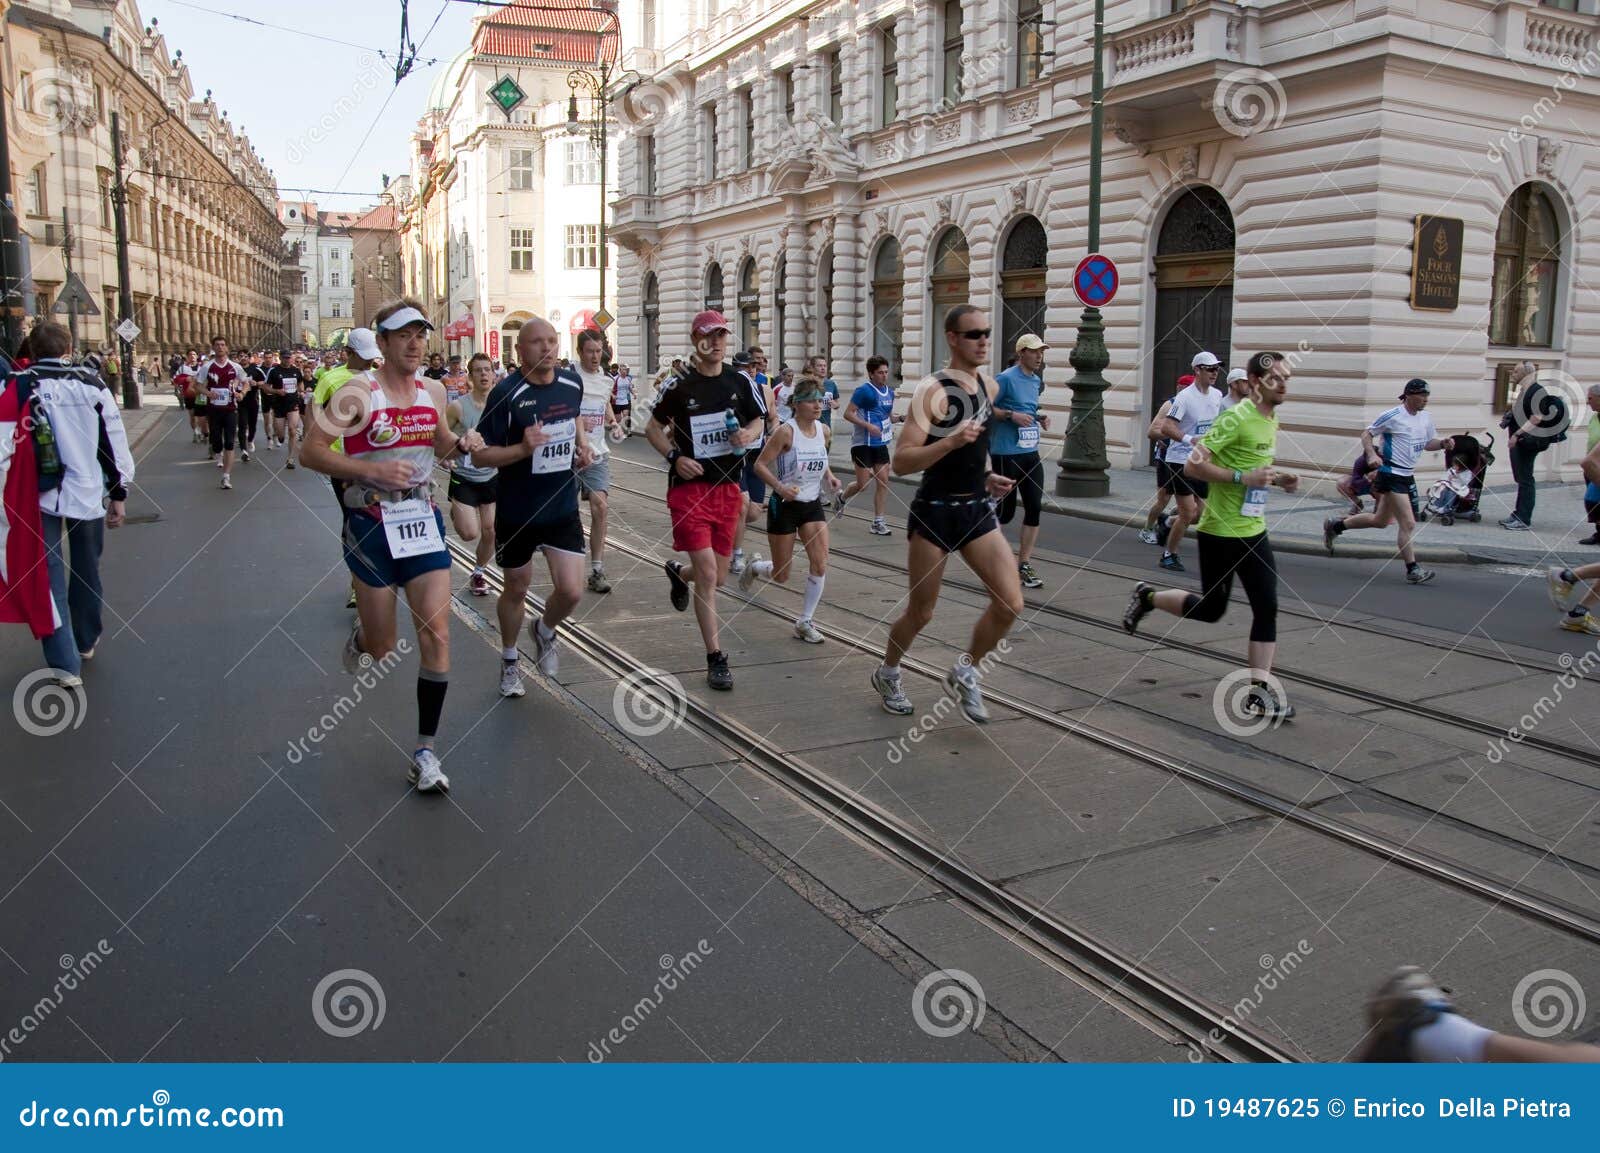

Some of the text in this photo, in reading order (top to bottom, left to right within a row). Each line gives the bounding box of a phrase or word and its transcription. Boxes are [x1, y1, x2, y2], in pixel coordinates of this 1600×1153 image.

[1422, 283, 1454, 297] HOTEL
[542, 441, 571, 459] 4148
[806, 460, 824, 472] 429
[397, 521, 427, 540] 1112
